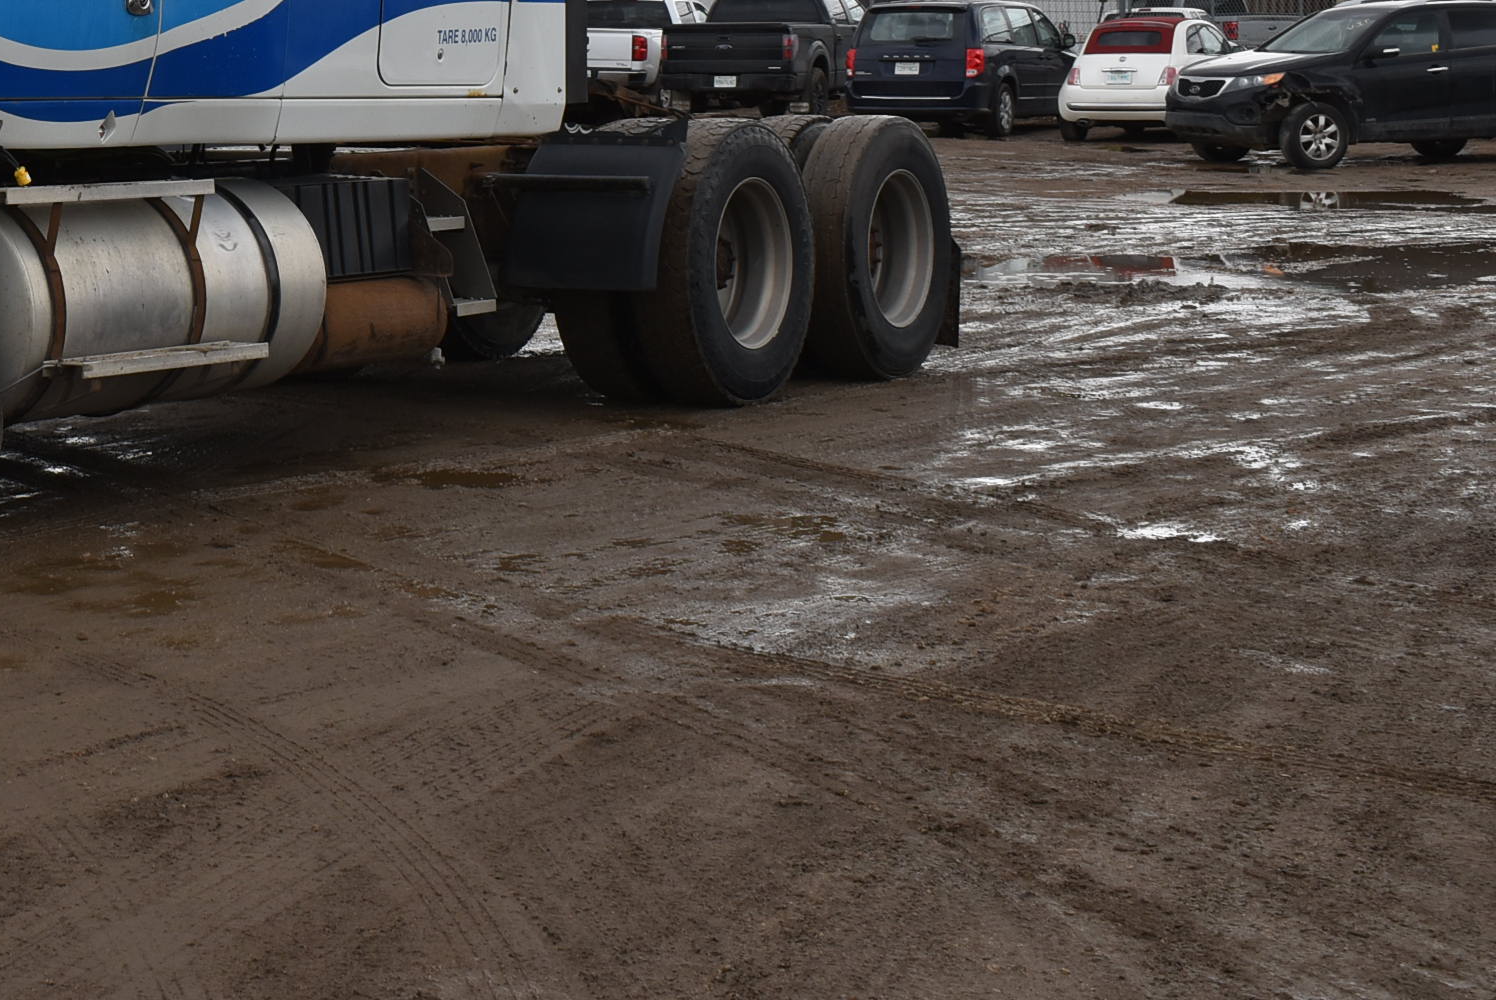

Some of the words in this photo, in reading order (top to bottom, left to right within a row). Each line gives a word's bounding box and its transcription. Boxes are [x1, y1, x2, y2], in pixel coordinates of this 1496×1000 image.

[437, 29, 459, 45] TARE
[461, 28, 483, 46] 8,000
[484, 27, 497, 43] KG
